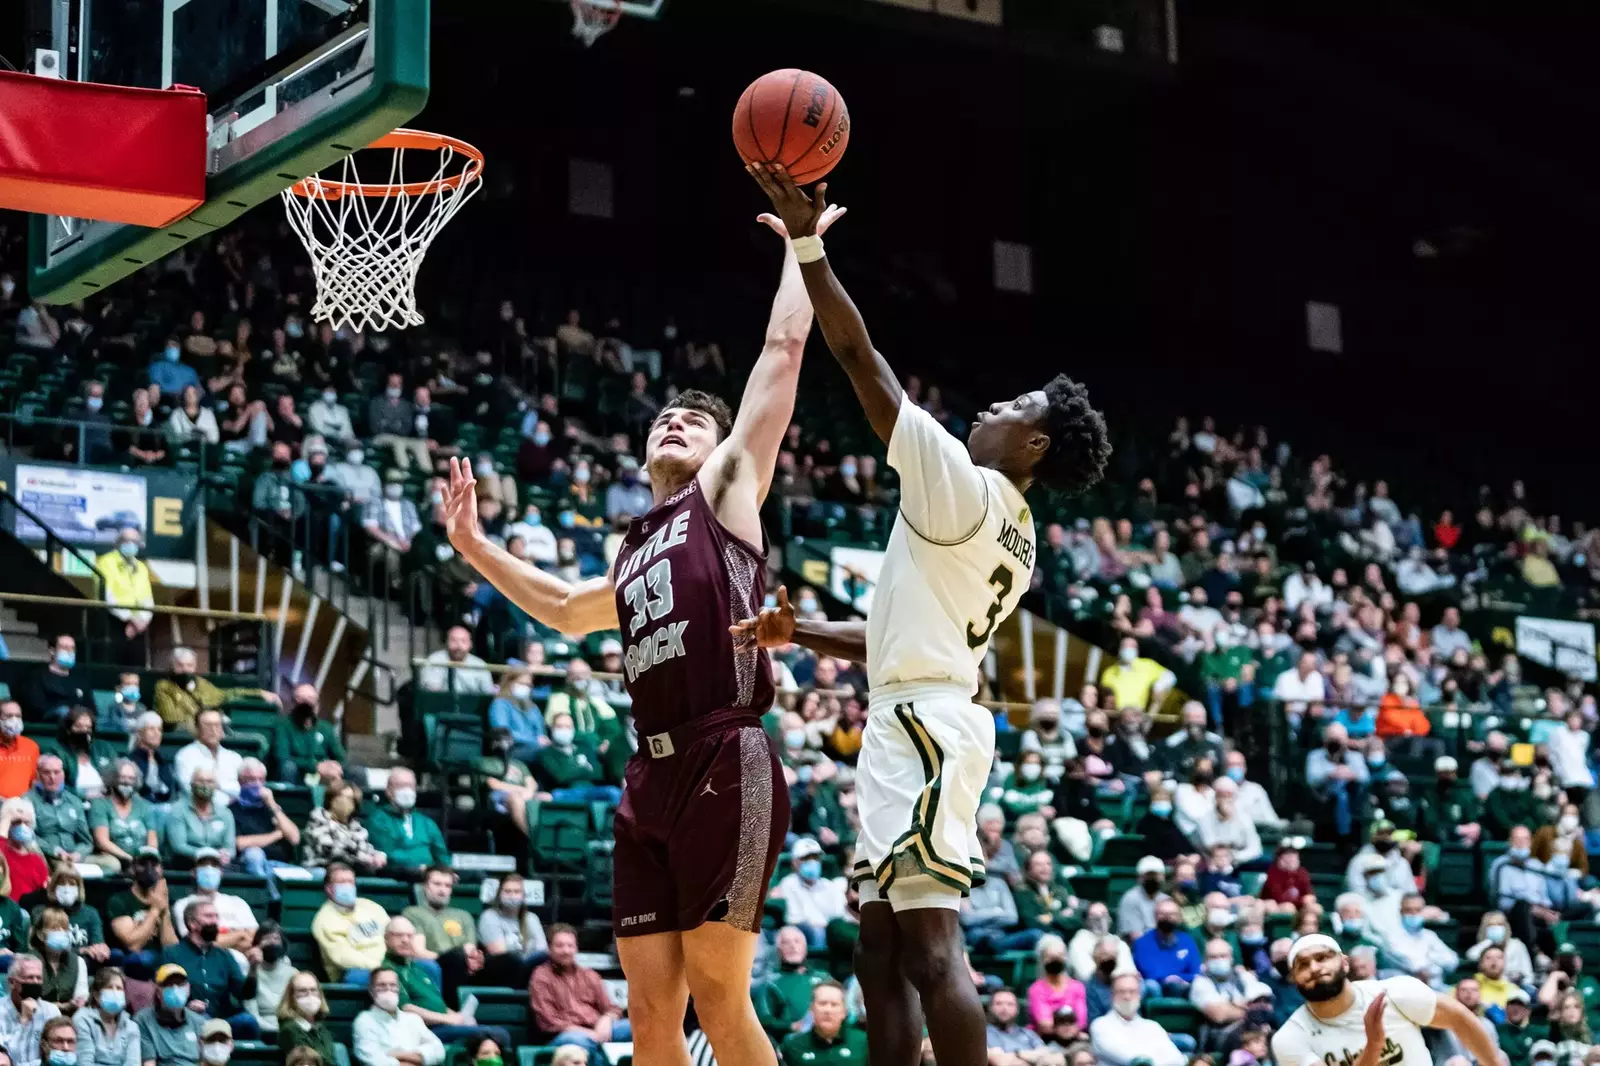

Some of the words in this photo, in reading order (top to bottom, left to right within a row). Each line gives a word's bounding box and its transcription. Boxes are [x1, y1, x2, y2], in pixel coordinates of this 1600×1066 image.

[615, 510, 691, 590] LITTLE
[624, 558, 674, 637] 33
[966, 563, 1014, 650] 3
[624, 620, 690, 683] ROCK
[621, 916, 638, 926] LITTLE
[638, 912, 657, 923] ROCK
